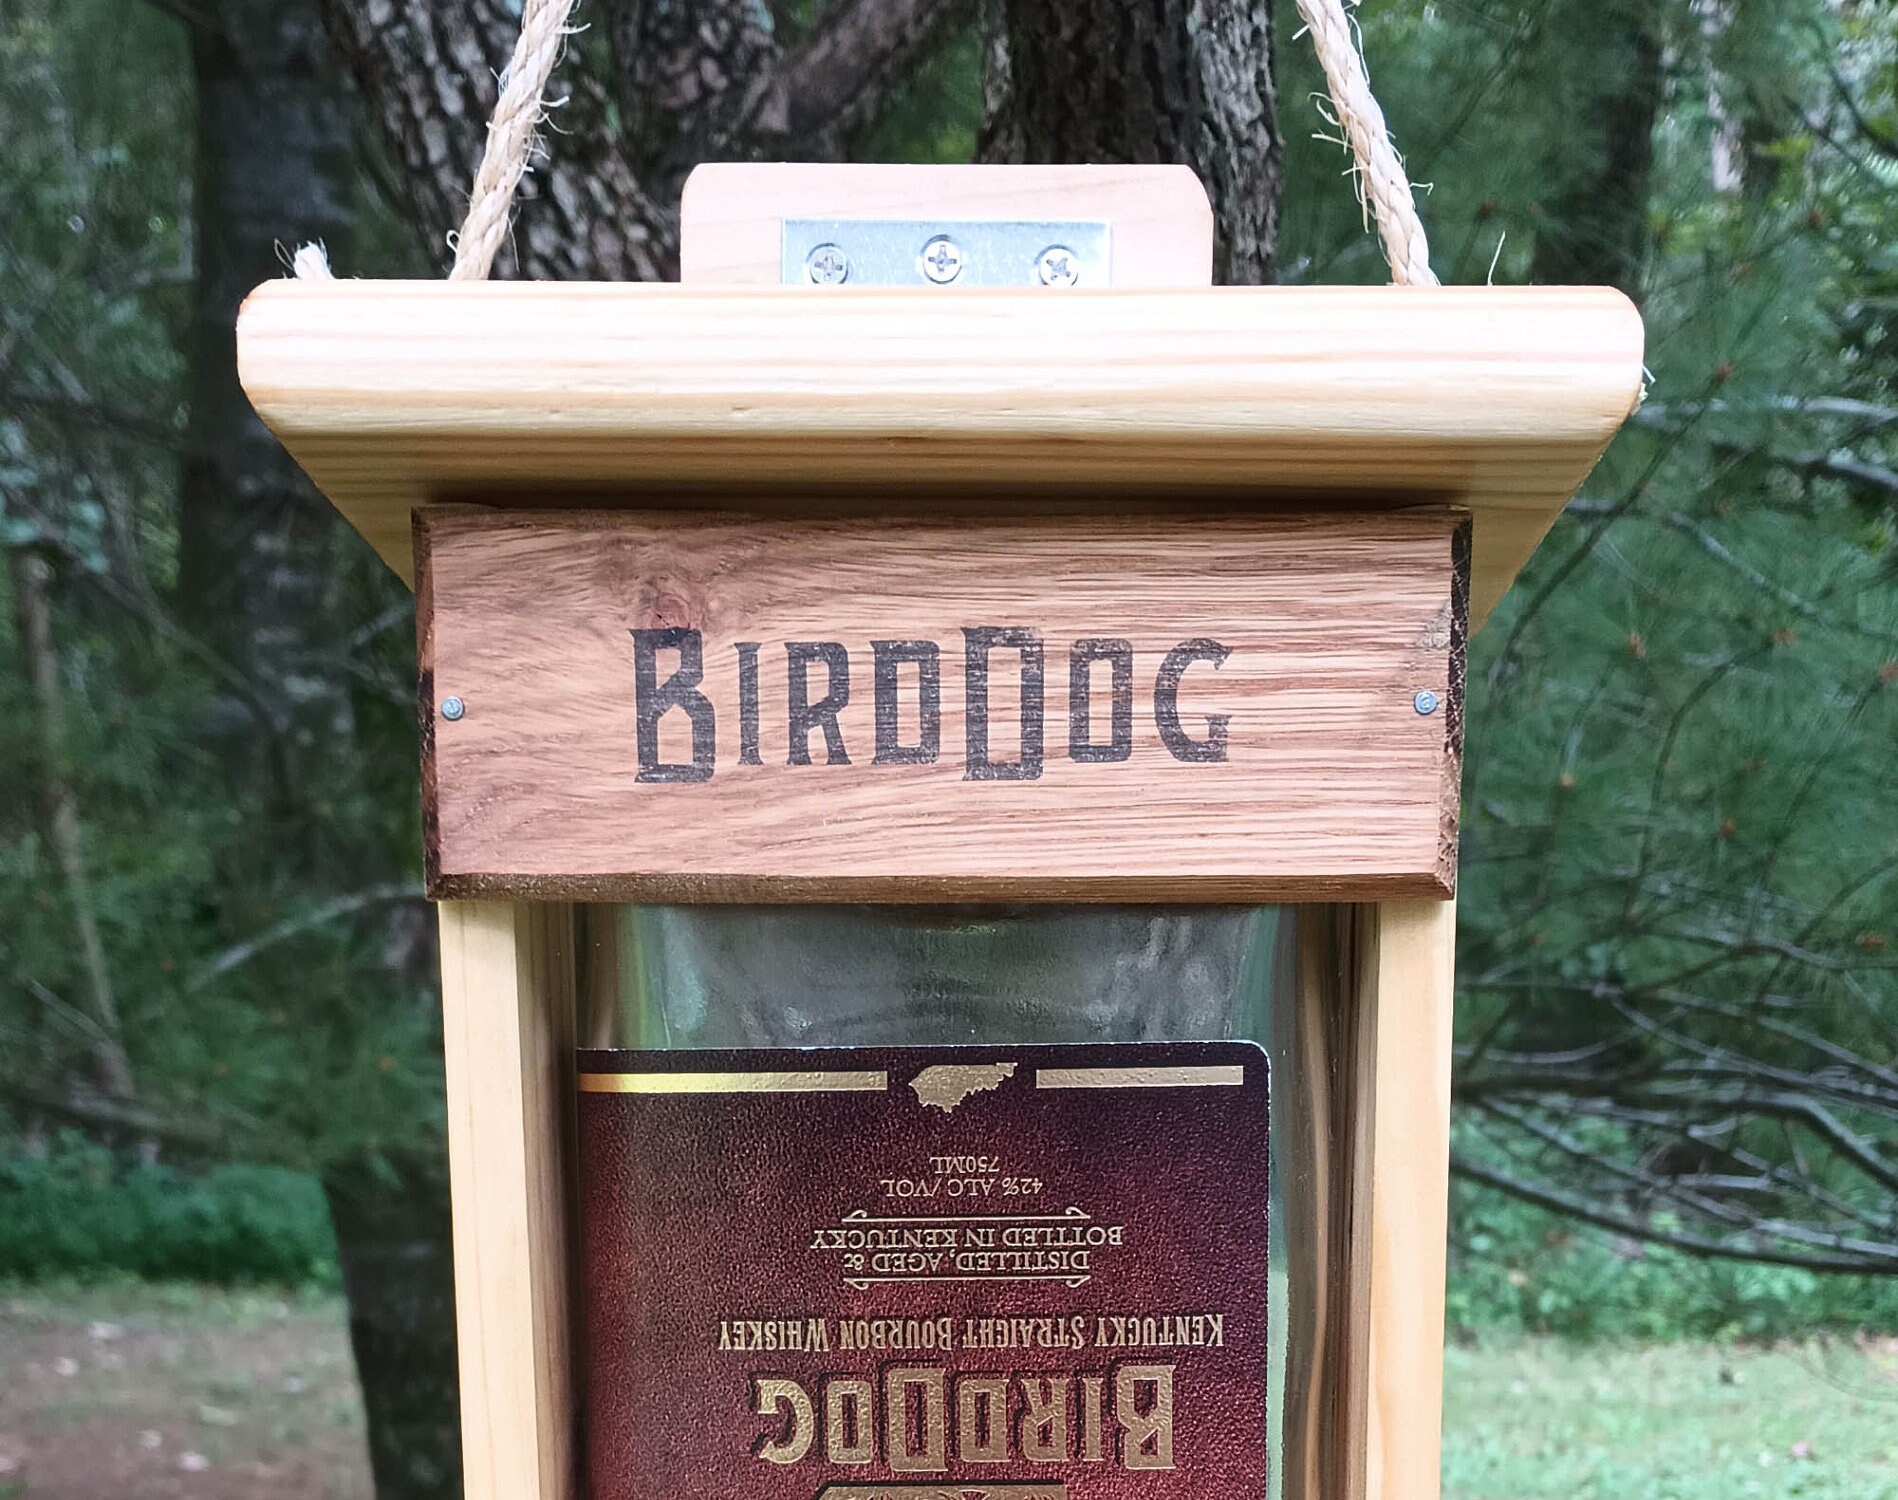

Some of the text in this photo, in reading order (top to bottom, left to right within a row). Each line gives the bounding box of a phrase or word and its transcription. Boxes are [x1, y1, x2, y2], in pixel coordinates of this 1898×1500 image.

[928, 1156, 1000, 1174] 750ML
[946, 1178, 996, 1196] ALC
[1002, 1177, 1043, 1196] 42%
[810, 1226, 1124, 1249] BOTTLED IN KENTUCKY
[843, 1249, 1090, 1272] DISTILLED, AGED &
[716, 1312, 1224, 1352] KENTUCKY STRAIGHT BOURBON WHISKEY
